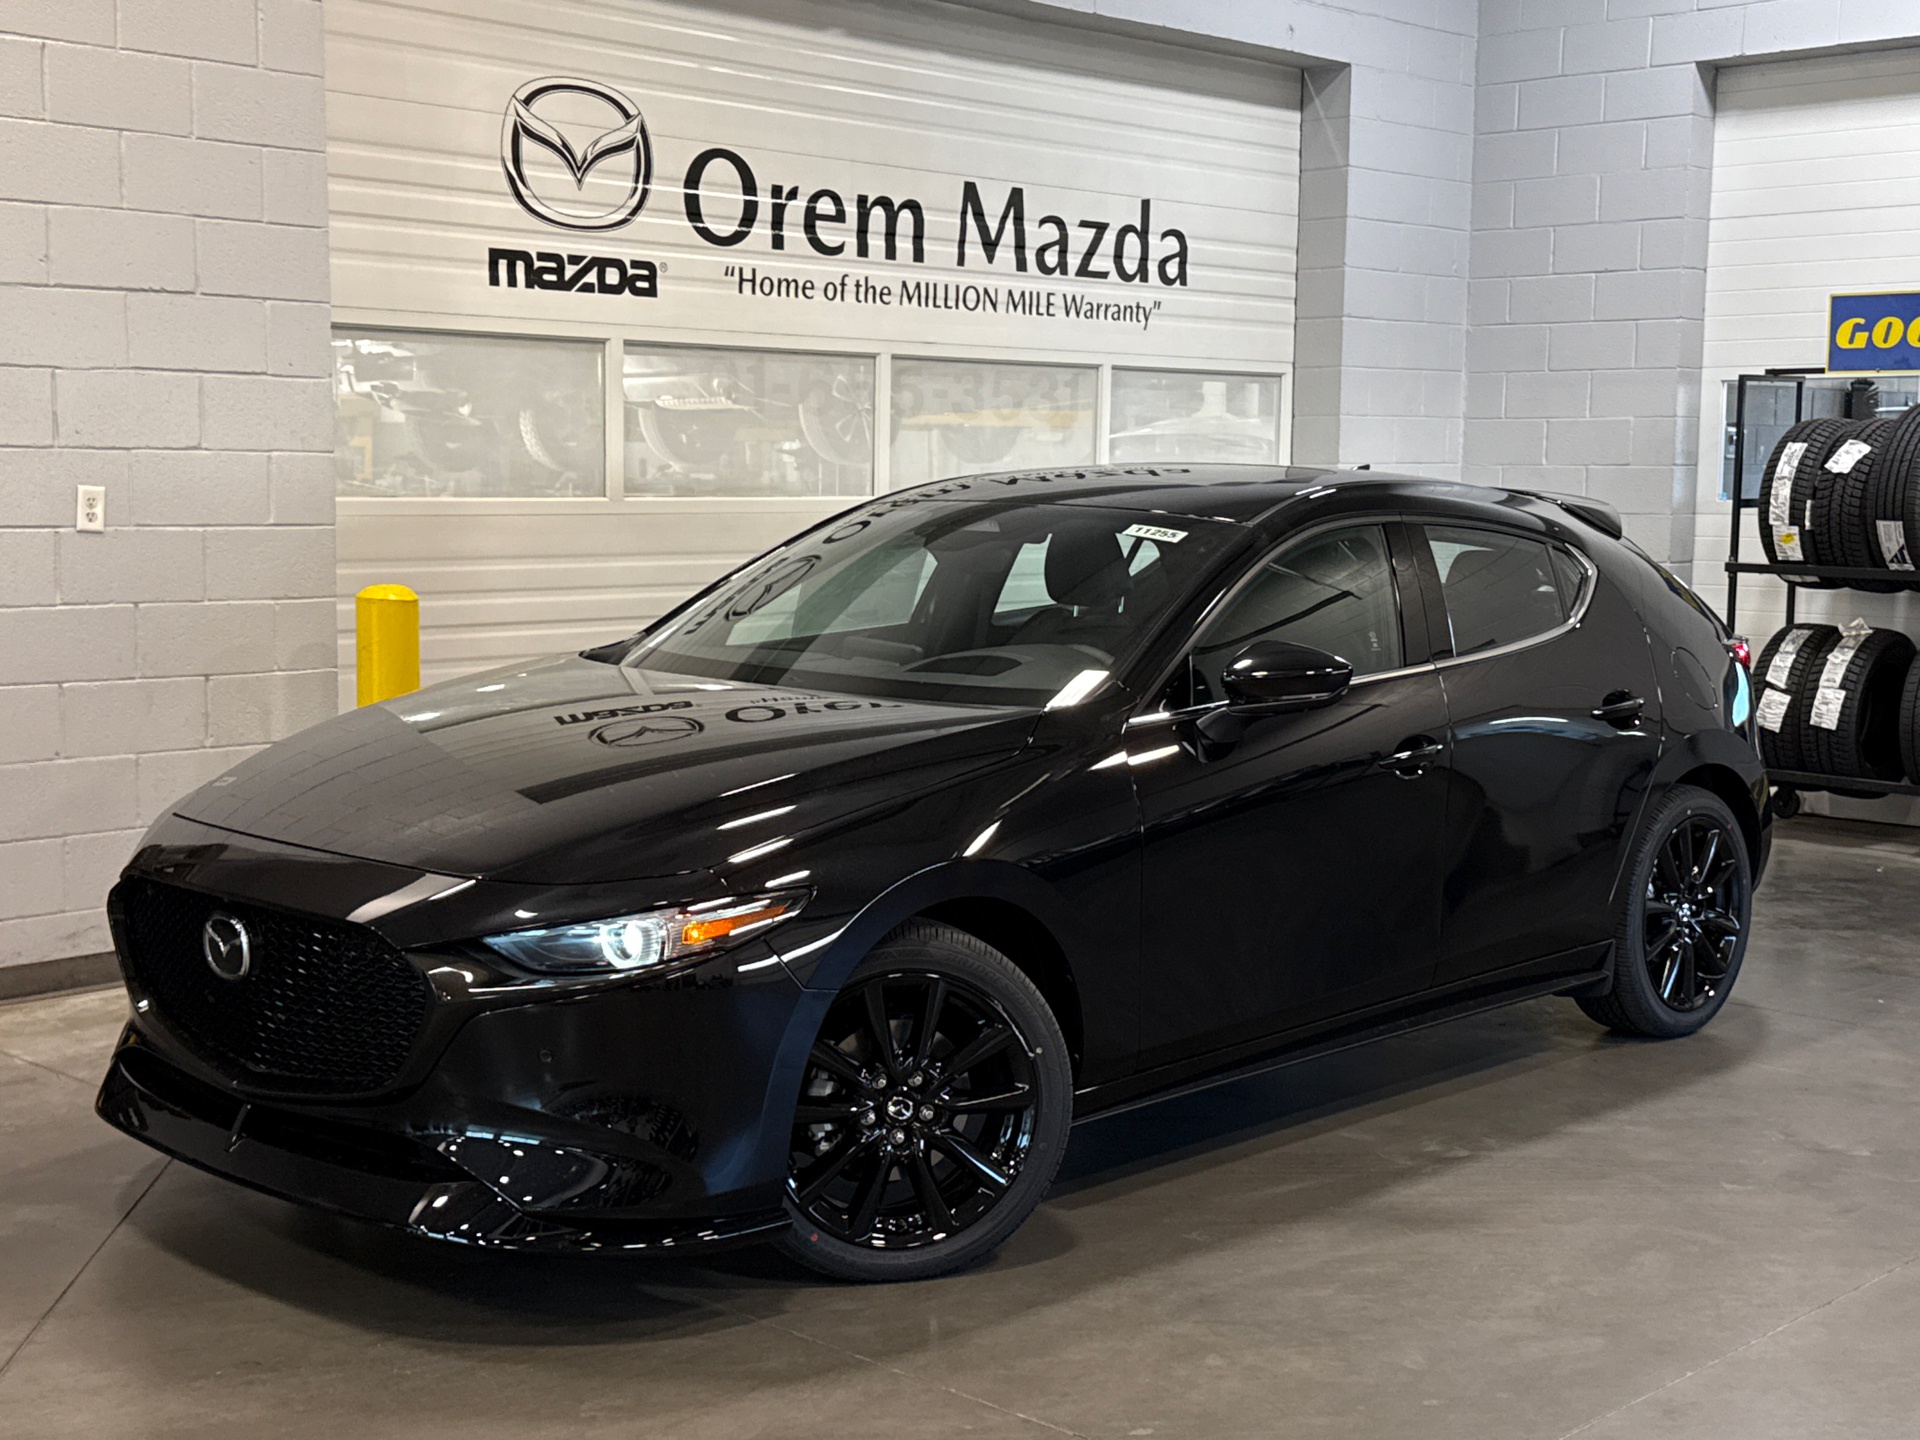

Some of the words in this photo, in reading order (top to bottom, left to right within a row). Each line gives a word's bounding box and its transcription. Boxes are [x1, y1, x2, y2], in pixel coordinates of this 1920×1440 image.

[683, 147, 925, 264] Orem
[956, 180, 1189, 287] Mazda
[823, 275, 849, 301] of
[854, 277, 892, 305] the
[899, 281, 998, 313] MILLION
[1006, 289, 1055, 317] MILE
